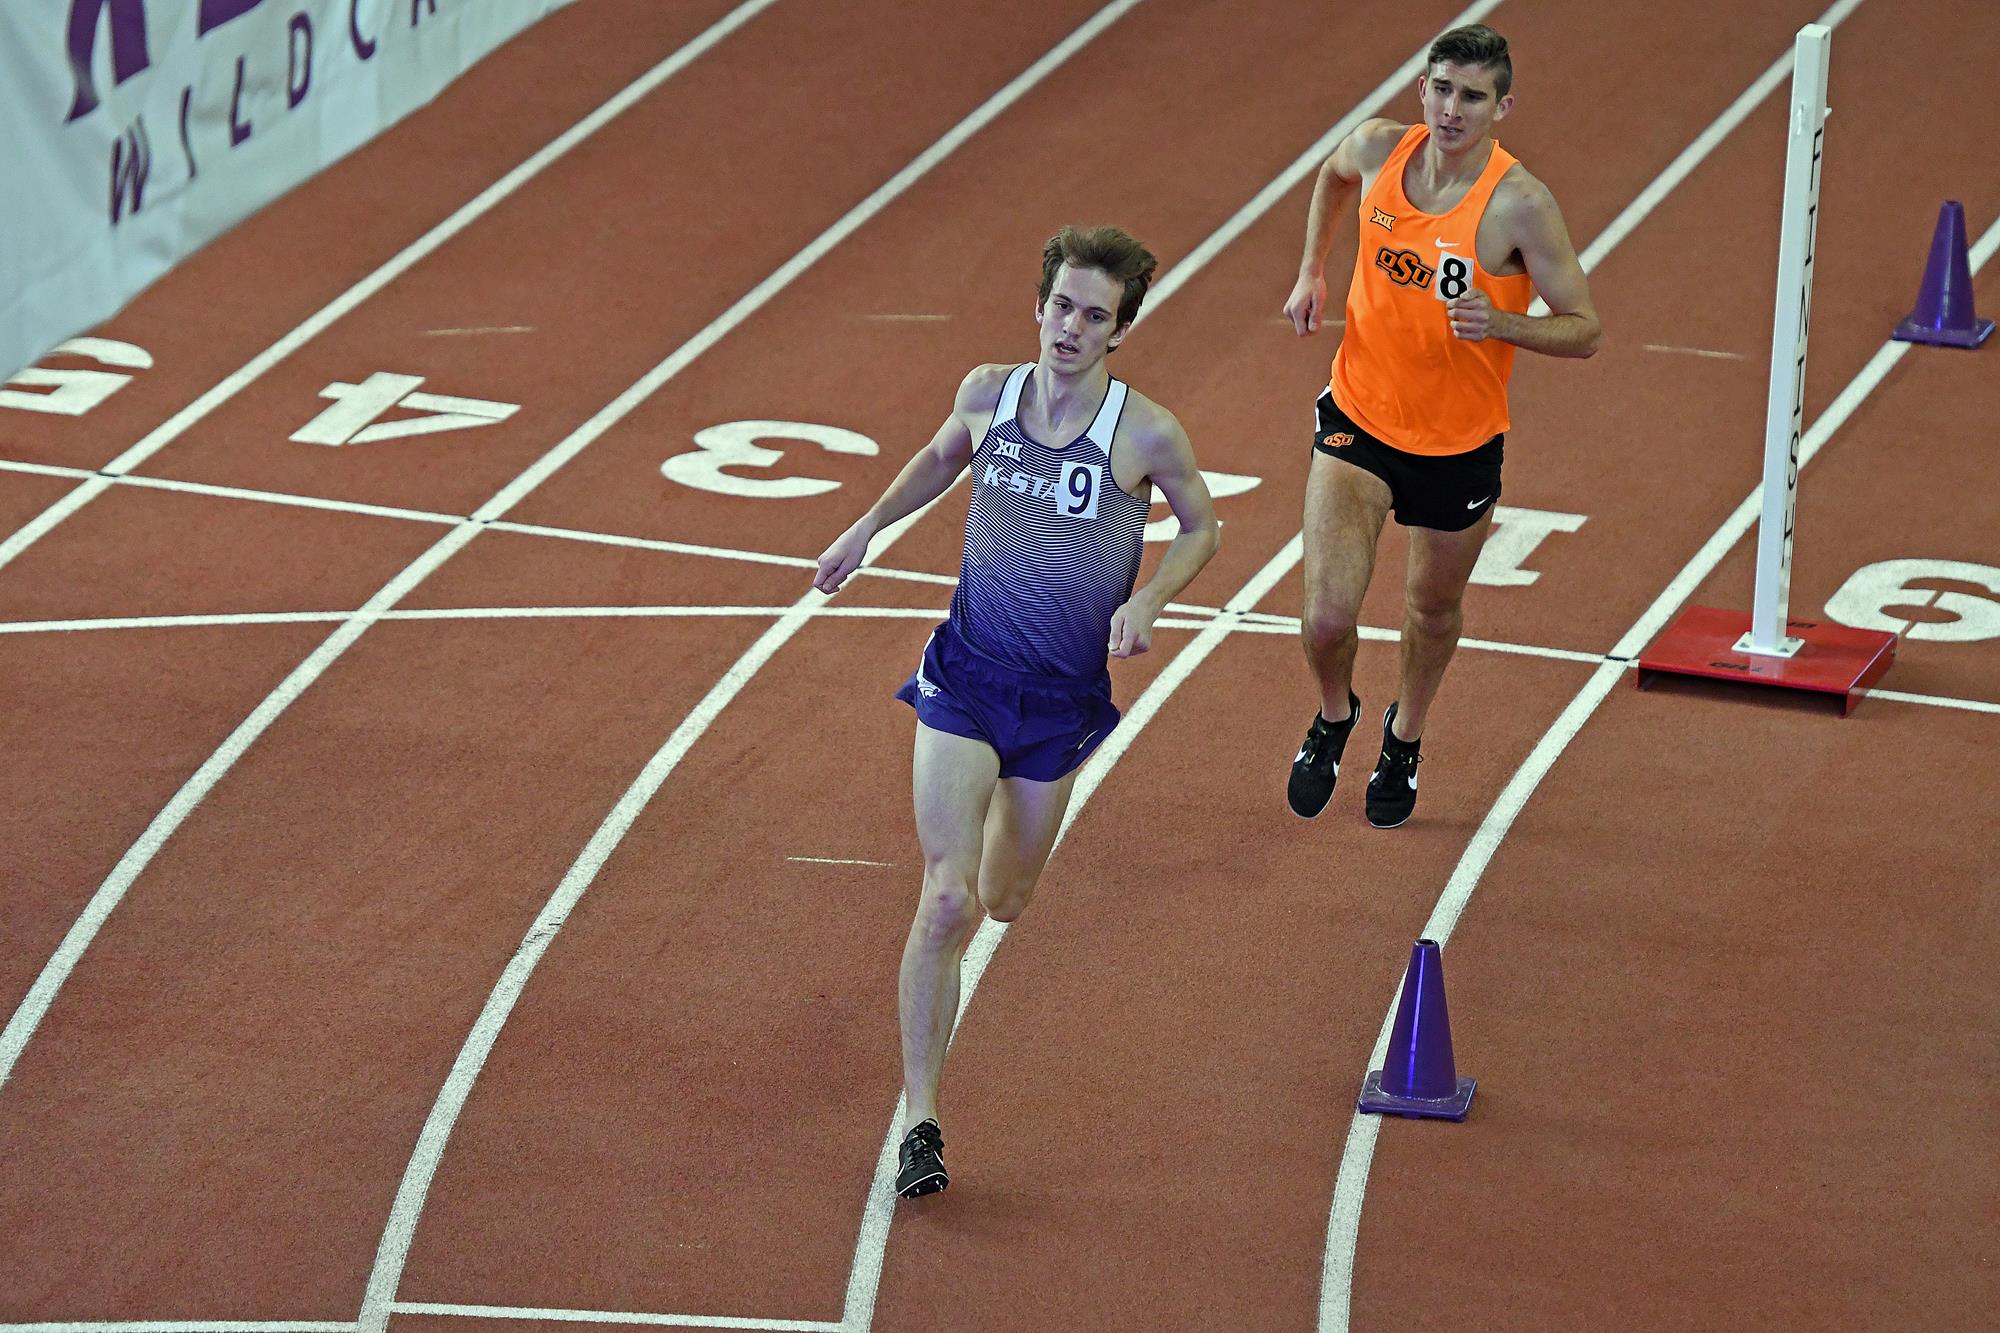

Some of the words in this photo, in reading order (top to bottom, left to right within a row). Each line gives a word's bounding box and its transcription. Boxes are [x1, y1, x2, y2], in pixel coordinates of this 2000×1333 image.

[1376, 248, 1435, 289] OSU
[1440, 257, 1468, 300] 8
[1782, 127, 1823, 568] FINISH
[288, 371, 522, 446] 4
[660, 419, 880, 498] 3
[1067, 466, 1093, 515] 9
